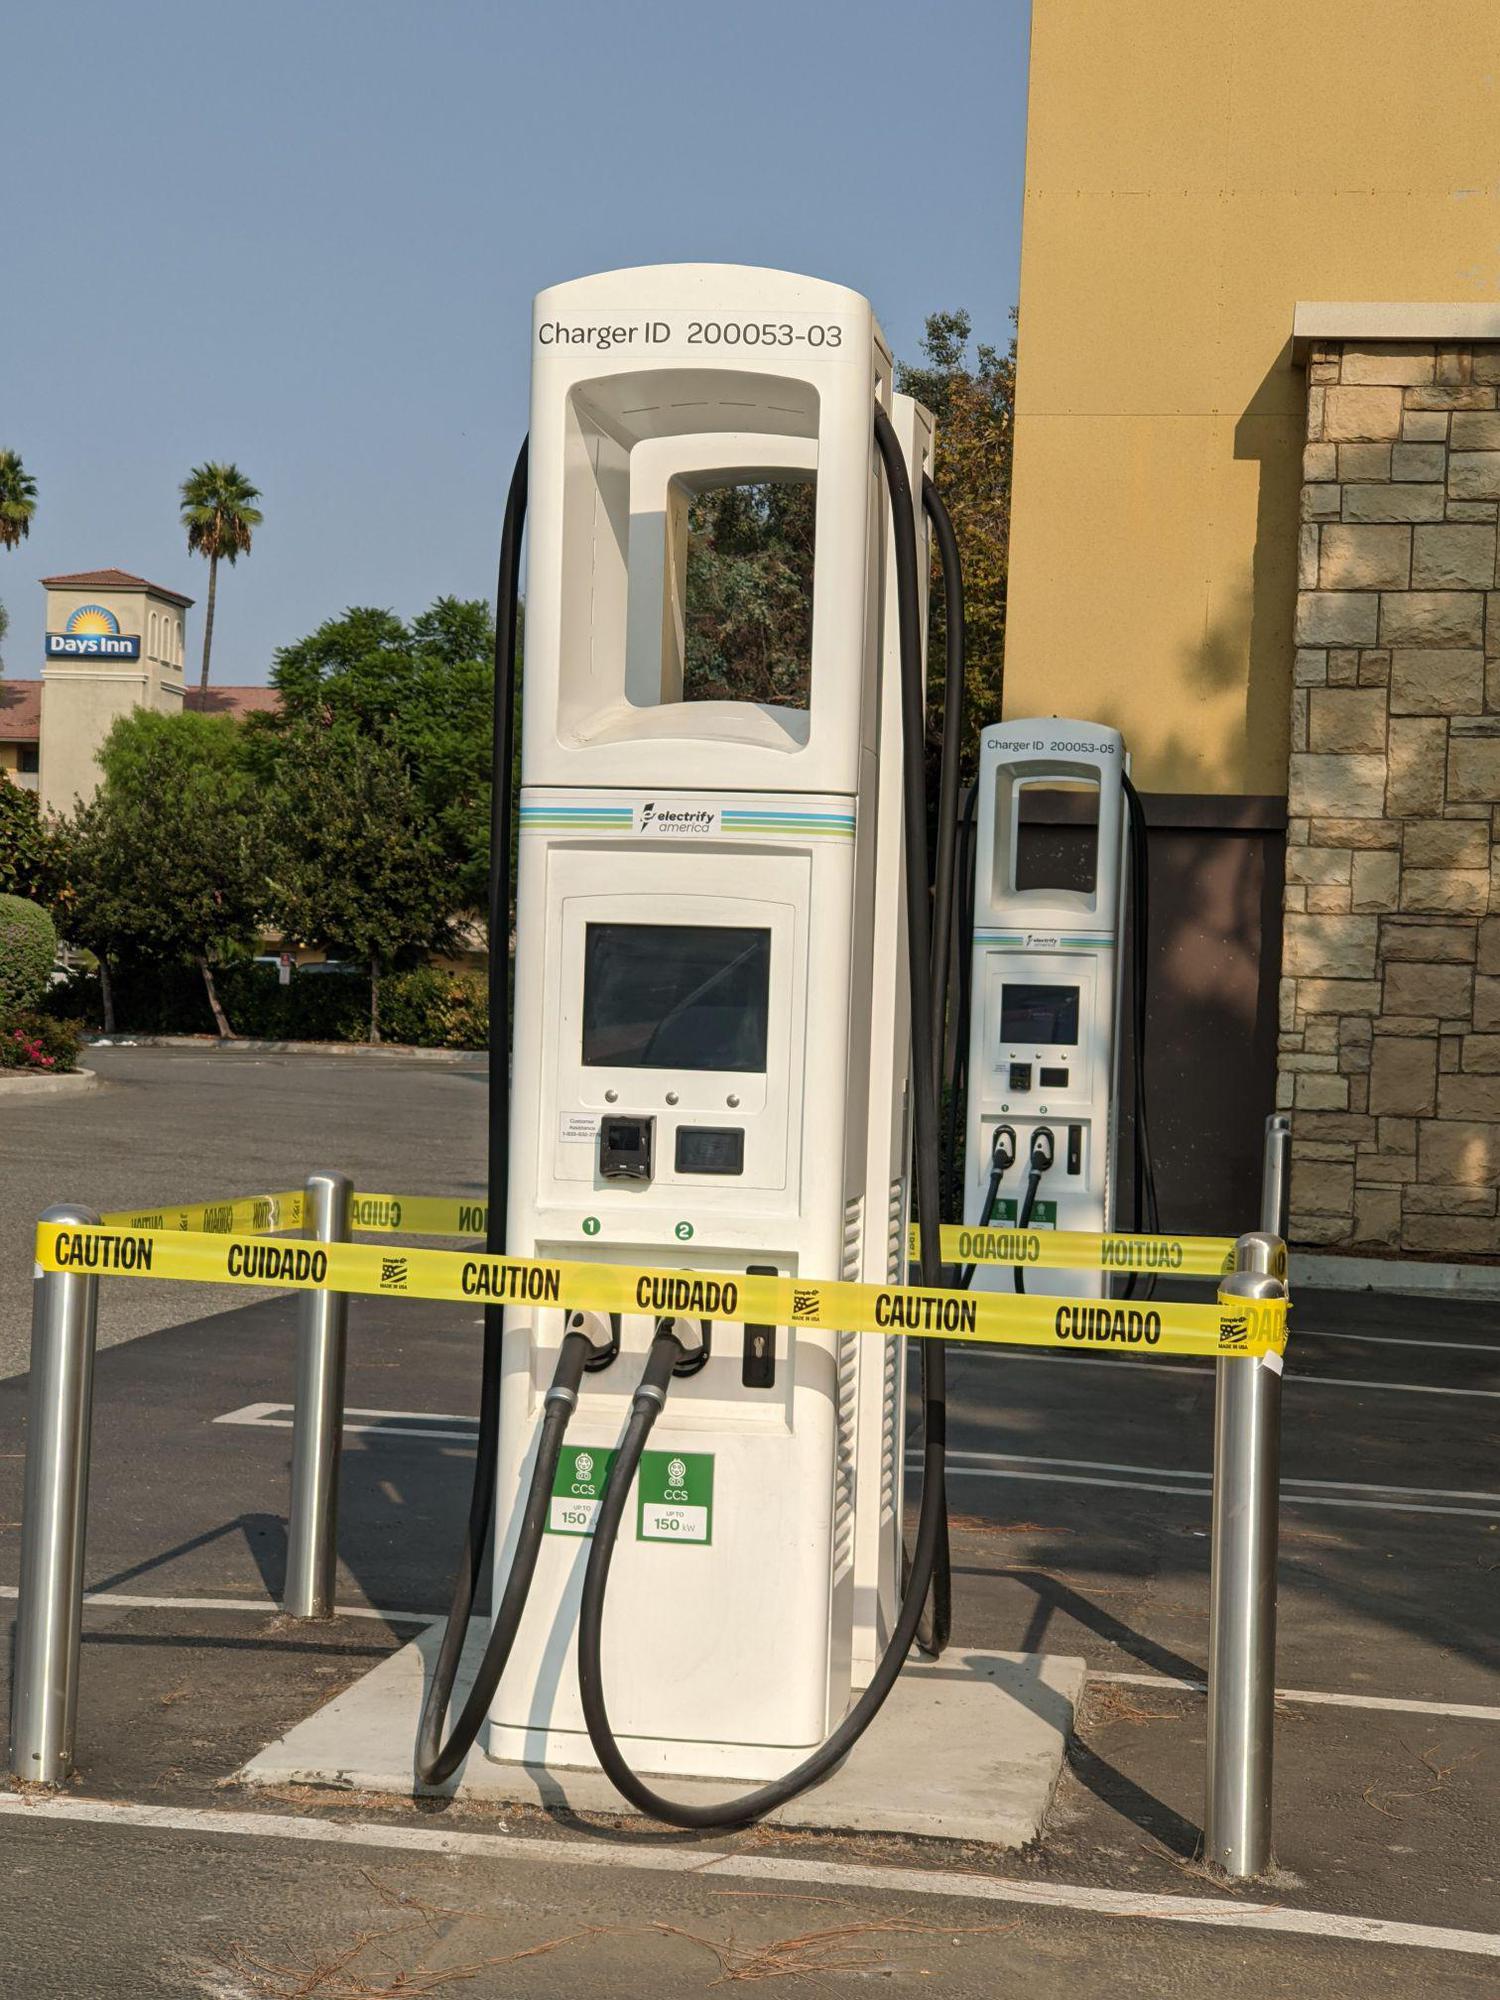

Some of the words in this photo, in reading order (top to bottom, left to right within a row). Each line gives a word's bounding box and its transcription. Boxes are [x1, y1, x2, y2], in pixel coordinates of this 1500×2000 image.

[538, 321, 639, 350] Charger
[645, 322, 671, 344] ID
[687, 322, 843, 348] 200053-03
[51, 636, 98, 653] Days
[100, 637, 133, 653] Inn
[987, 739, 1031, 752] Charger
[1032, 740, 1045, 751] ID
[1050, 741, 1115, 754] 200053-05
[657, 810, 715, 824] electrify
[658, 822, 710, 833] america
[587, 1219, 594, 1232] 1
[679, 1224, 689, 1237] 2
[55, 1232, 153, 1270] CAUTION
[227, 1244, 328, 1283] CUIDADO
[461, 1262, 560, 1301] CAUTION
[636, 1275, 738, 1315] CUIDADO
[875, 1293, 977, 1333] CAUTION
[1055, 1305, 1161, 1344] CUIDADO
[571, 1483, 596, 1495] CCS
[664, 1489, 689, 1501] CCS
[561, 1511, 587, 1525] 150
[654, 1518, 680, 1531] 150
[682, 1524, 696, 1532] kW
